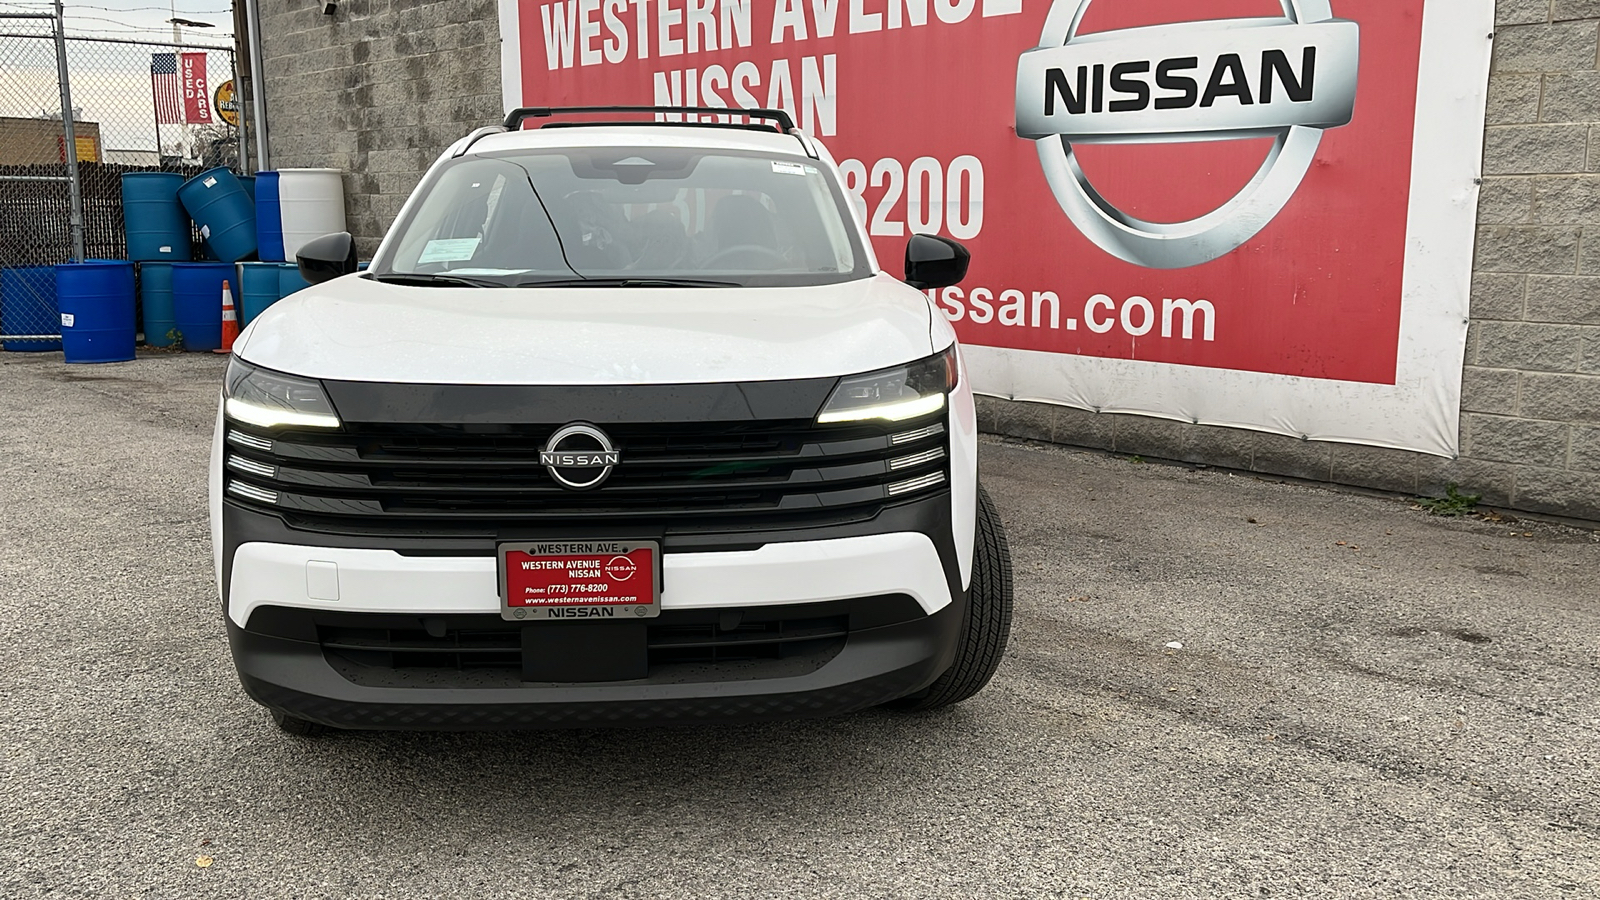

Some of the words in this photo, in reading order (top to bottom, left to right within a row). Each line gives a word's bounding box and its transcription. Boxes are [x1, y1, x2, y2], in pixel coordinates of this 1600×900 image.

[540, 0, 752, 71] WESTERN
[184, 59, 194, 98] USED
[1044, 46, 1316, 116] NISSAN
[196, 79, 208, 118] CARS
[653, 53, 837, 137] NISSAN
[542, 454, 617, 465] NISSAN
[537, 543, 592, 554] WESTERN
[596, 543, 621, 553] AVE.
[521, 560, 564, 570] WESTERN
[566, 560, 601, 569] AVENUE
[568, 569, 601, 578] NISSAN
[547, 584, 569, 595] (773)
[570, 583, 608, 593] 776-8200
[525, 595, 637, 604] www.westernavenissan.com
[548, 606, 614, 618] NISSAN
